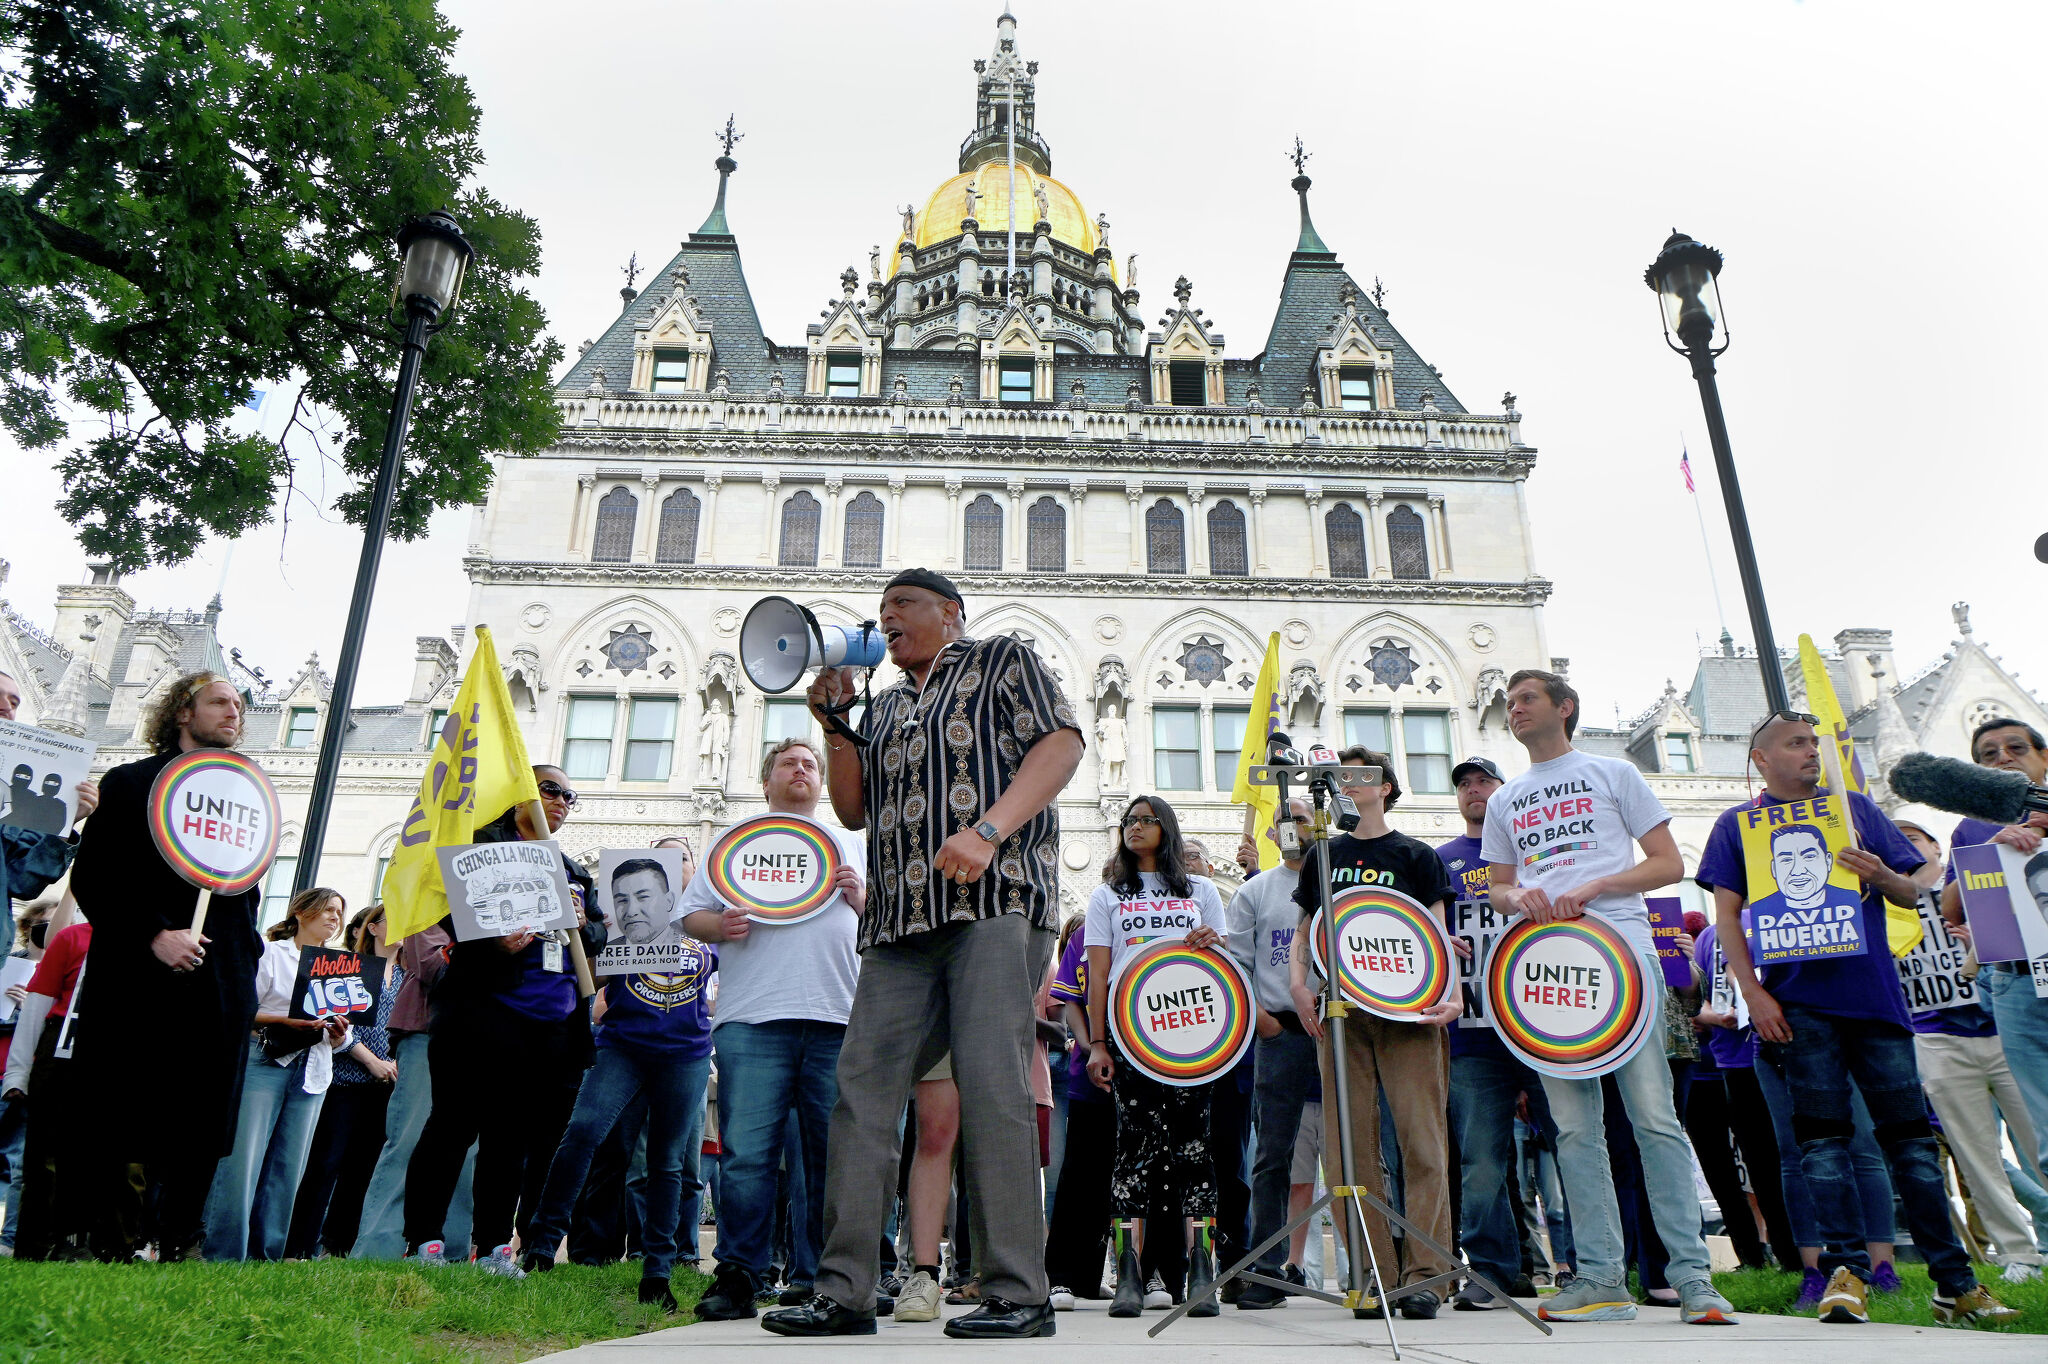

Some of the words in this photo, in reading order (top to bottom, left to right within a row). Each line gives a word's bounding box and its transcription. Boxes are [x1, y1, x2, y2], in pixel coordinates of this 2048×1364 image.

[17, 743, 26, 751] TO
[28, 746, 40, 754] THE
[19, 732, 34, 741] THE
[1512, 790, 1540, 812] WE
[1544, 779, 1593, 799] WILL
[185, 791, 260, 830] UNITE
[1513, 797, 1594, 835] NEVER
[1747, 797, 1831, 829] FREE
[183, 814, 256, 852] HERE!
[1518, 832, 1541, 852] GO
[1544, 819, 1595, 842] BACK
[457, 847, 501, 877] CHINGA
[501, 846, 518, 863] LA
[518, 846, 554, 868] MIGRA
[743, 853, 808, 868] UNITE
[741, 867, 806, 884] HERE!
[1117, 890, 1147, 902] WE
[1119, 899, 1195, 916] NEVER
[1121, 915, 1146, 932] GO
[1151, 914, 1196, 930] BACK
[1758, 905, 1856, 930] DAVID
[1347, 935, 1414, 955] UNITE
[1759, 920, 1860, 951] HUERTA
[632, 957, 657, 965] RAIDS
[636, 945, 681, 956] DAVID
[1763, 951, 1787, 961] SHOW
[1789, 949, 1805, 957] ICE
[1808, 947, 1819, 956] LA
[1820, 942, 1860, 954] PUERTA!
[310, 953, 362, 977] Abolish
[1351, 953, 1415, 975] HERE!
[1525, 962, 1601, 987] UNITE
[1899, 958, 1923, 977] ND
[1931, 950, 1963, 972] ICE
[307, 976, 369, 1016] ICE
[1146, 985, 1214, 1012] UNITE
[1524, 984, 1599, 1010] HERE!
[1150, 1004, 1216, 1033] HERE!
